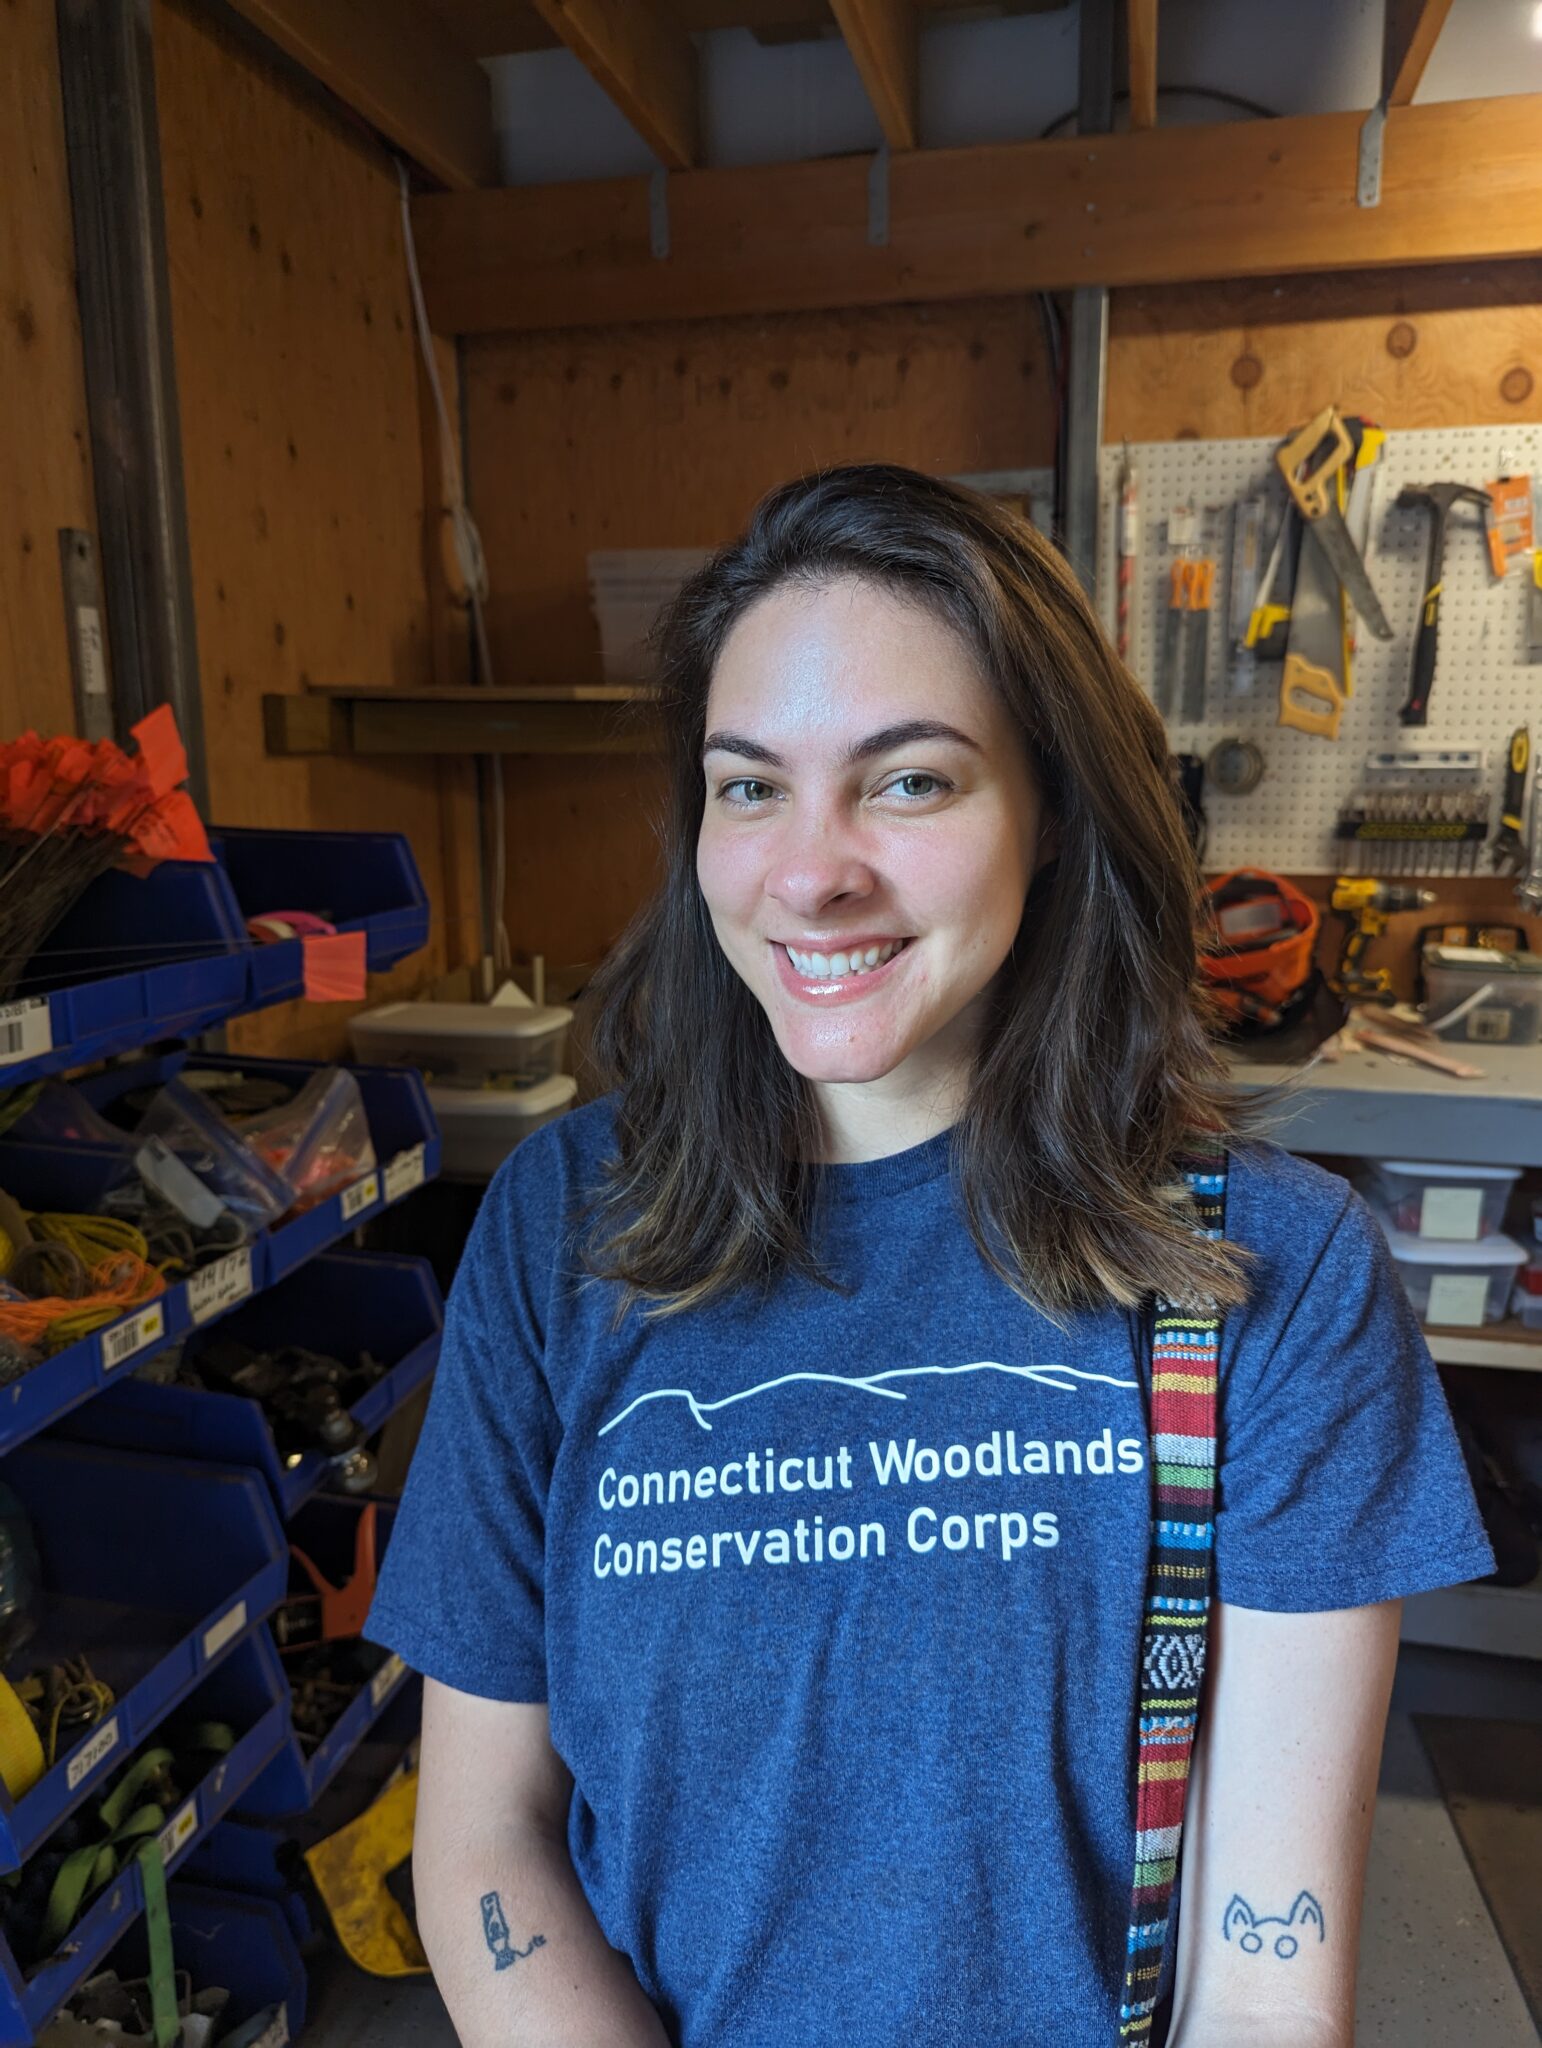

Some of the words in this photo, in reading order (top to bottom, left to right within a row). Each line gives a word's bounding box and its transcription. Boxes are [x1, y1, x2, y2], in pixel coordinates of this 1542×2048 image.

[598, 1446, 853, 1511] Connecticut
[868, 1428, 1145, 1485] Woodlands
[593, 1516, 886, 1578] Conservation
[906, 1506, 1060, 1561] Corps
